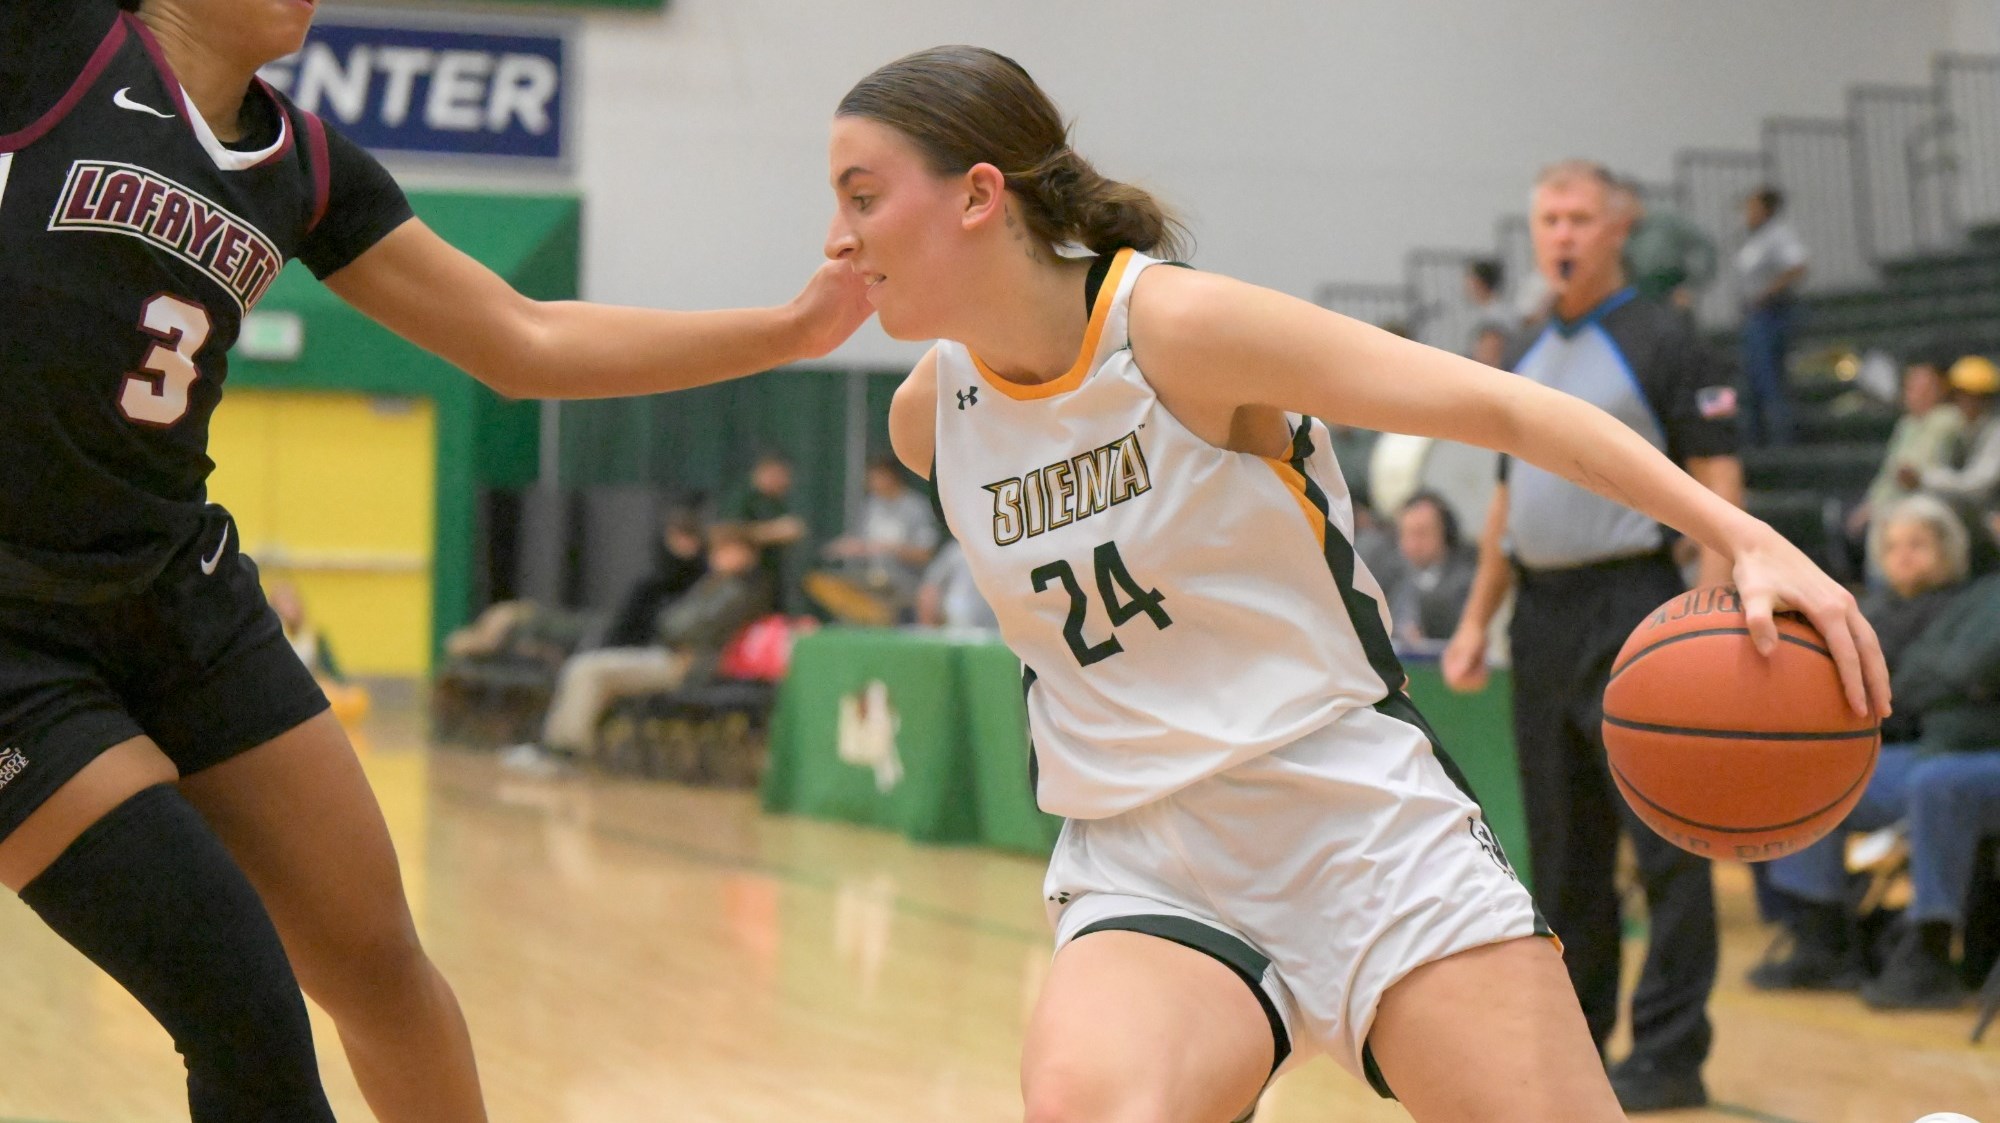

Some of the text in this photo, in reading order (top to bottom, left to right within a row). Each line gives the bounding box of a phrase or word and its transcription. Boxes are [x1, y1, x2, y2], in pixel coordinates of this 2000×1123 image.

[118, 291, 211, 429] 3
[981, 430, 1152, 547] SIENA
[1030, 540, 1173, 667] 24
